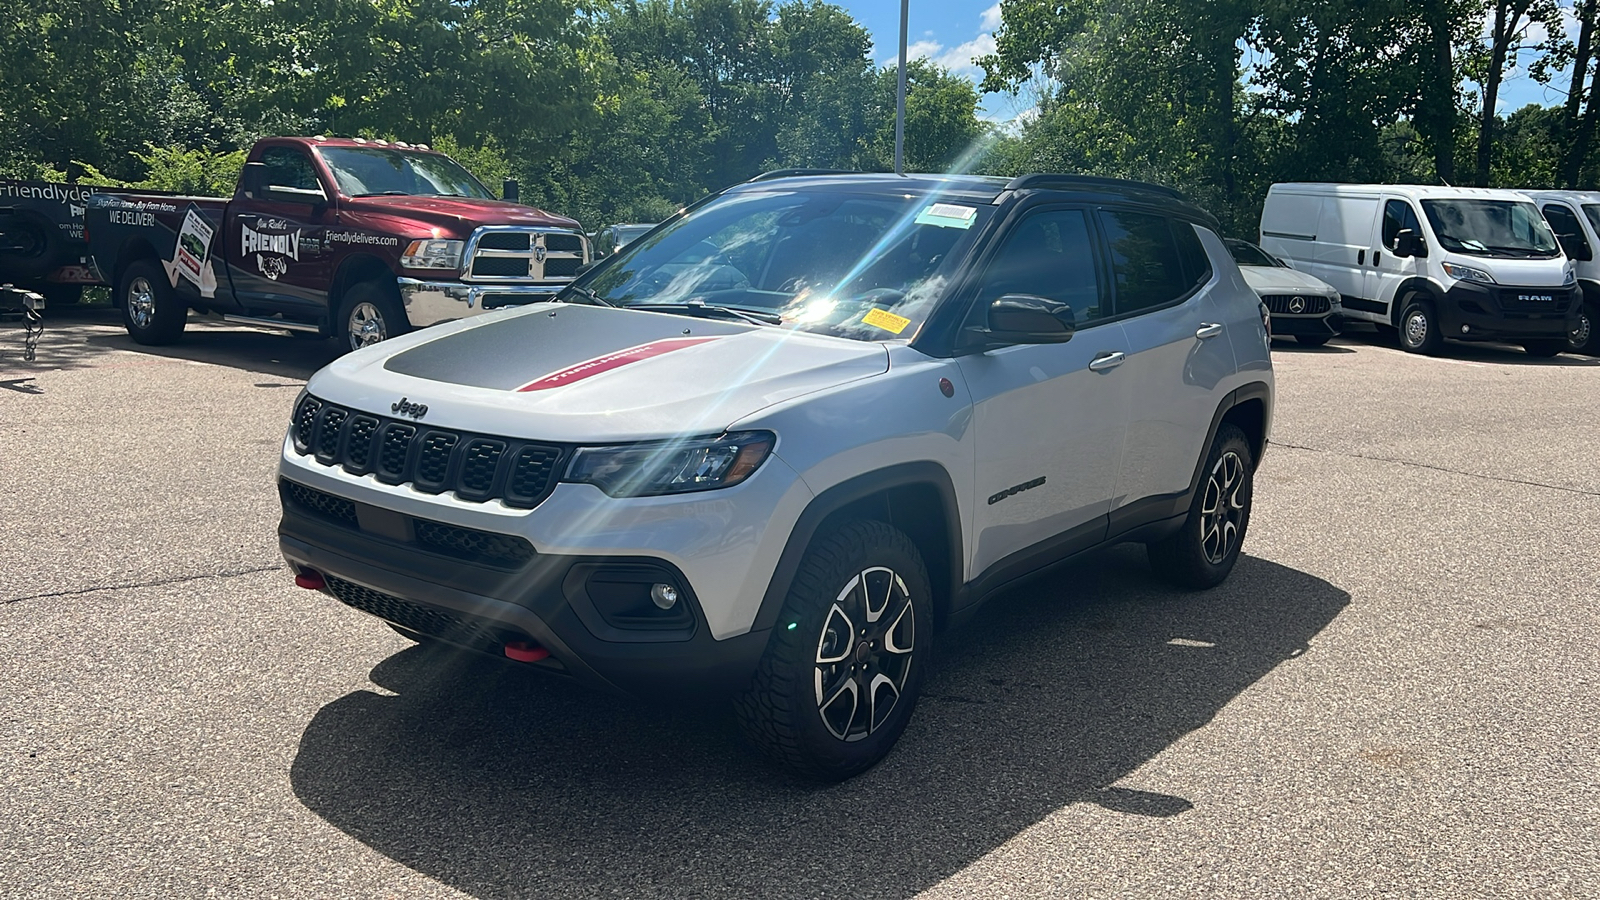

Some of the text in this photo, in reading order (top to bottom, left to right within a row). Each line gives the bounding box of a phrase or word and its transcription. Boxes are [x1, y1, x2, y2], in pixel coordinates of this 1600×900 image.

[146, 201, 160, 210] From
[160, 202, 177, 212] Home
[109, 210, 155, 227] WE DELIVER!
[241, 223, 301, 262] FRIENDLY
[326, 230, 398, 246] Friendlydelivers.com
[544, 346, 653, 382] TRAILHAWK
[391, 397, 429, 419] Jeep
